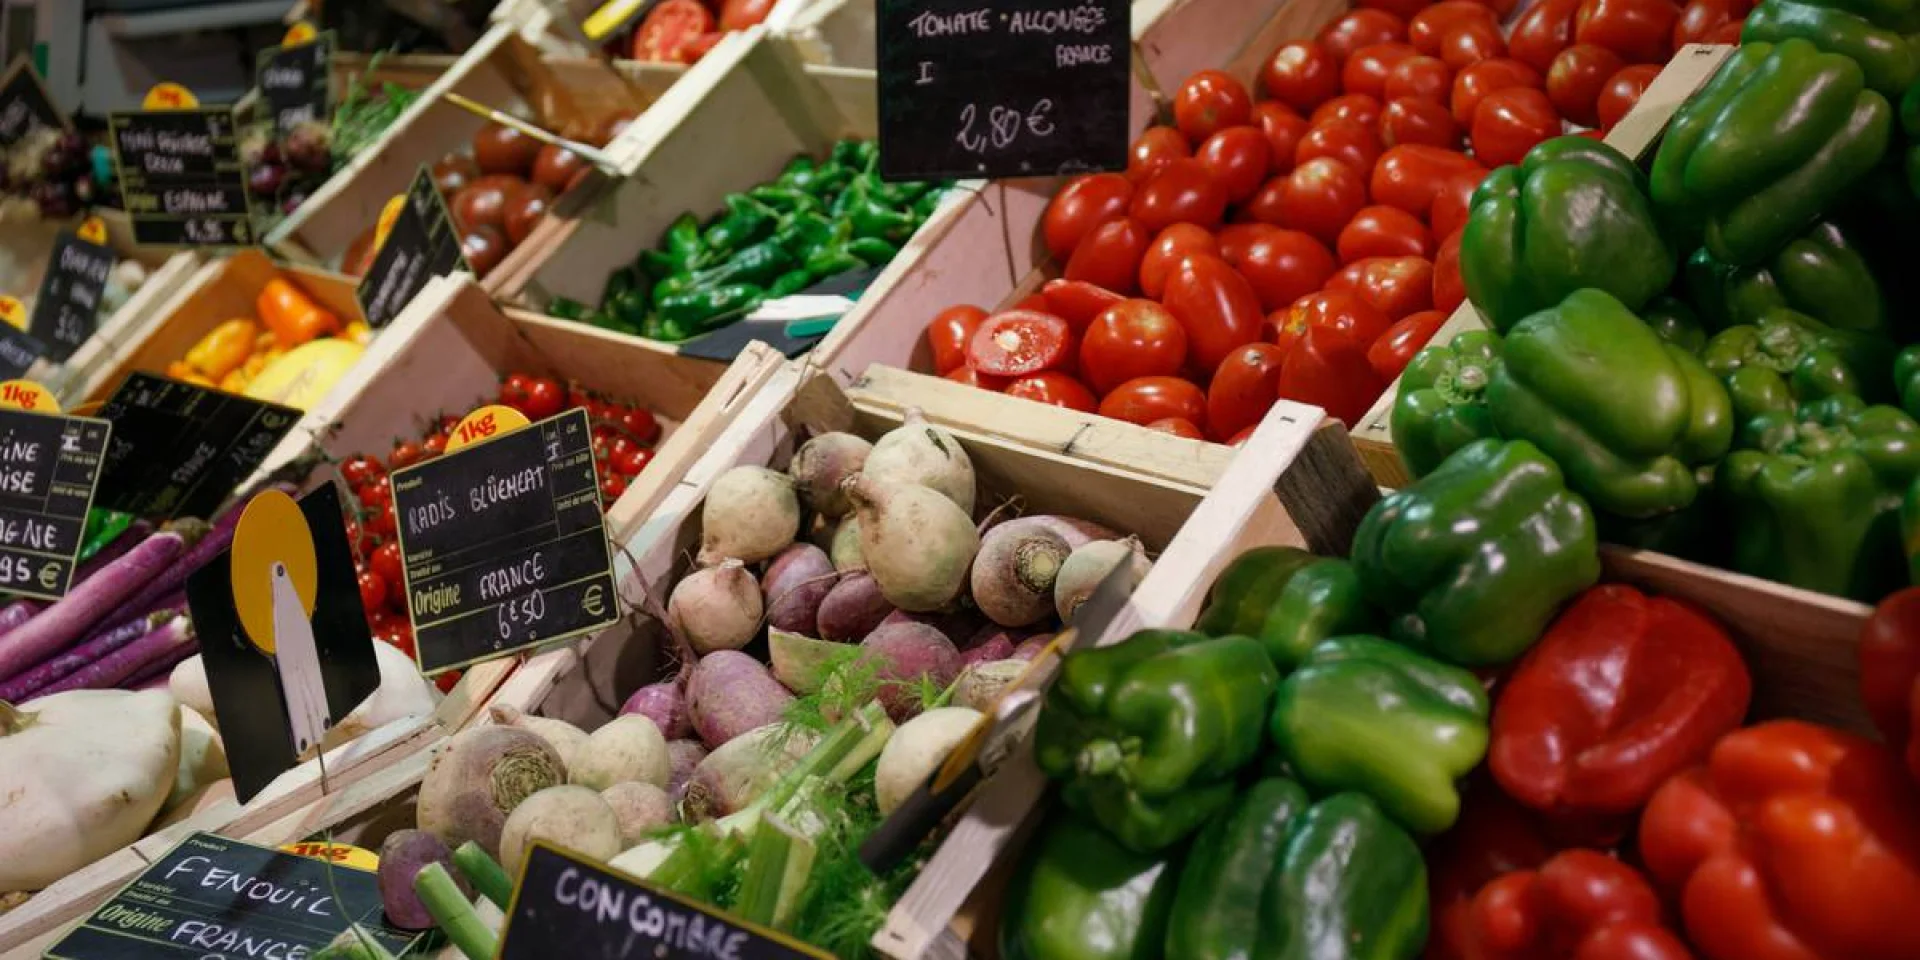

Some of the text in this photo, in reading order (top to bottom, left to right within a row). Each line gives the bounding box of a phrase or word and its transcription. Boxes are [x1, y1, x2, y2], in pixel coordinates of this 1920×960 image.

[908, 8, 992, 37] TOMATE
[956, 98, 1055, 153] 2,80 €
[3, 383, 39, 410] 1kg
[457, 411, 498, 446] 1kg
[414, 551, 546, 617] Origine FRANCE
[581, 584, 606, 617] €
[98, 903, 312, 960] Origine FRANCE
